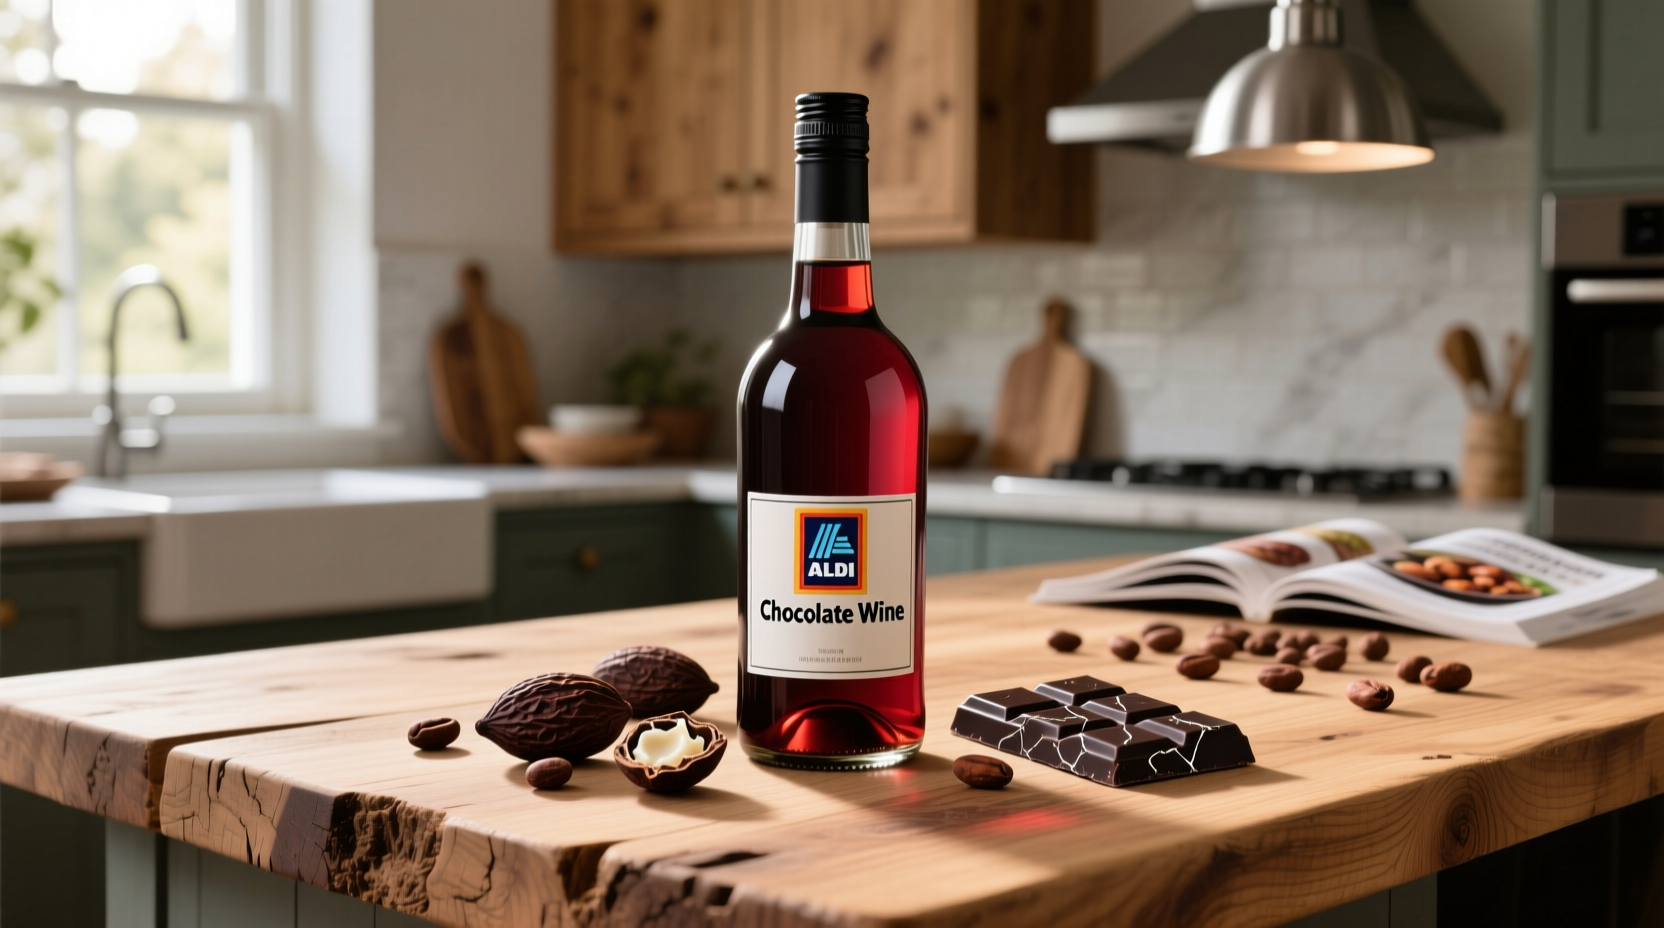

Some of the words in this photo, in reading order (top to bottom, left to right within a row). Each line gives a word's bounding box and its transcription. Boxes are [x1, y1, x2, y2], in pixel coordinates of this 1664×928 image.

[808, 562, 855, 577] ALDI
[760, 599, 854, 624] Chocolate
[858, 600, 905, 624] Wine
